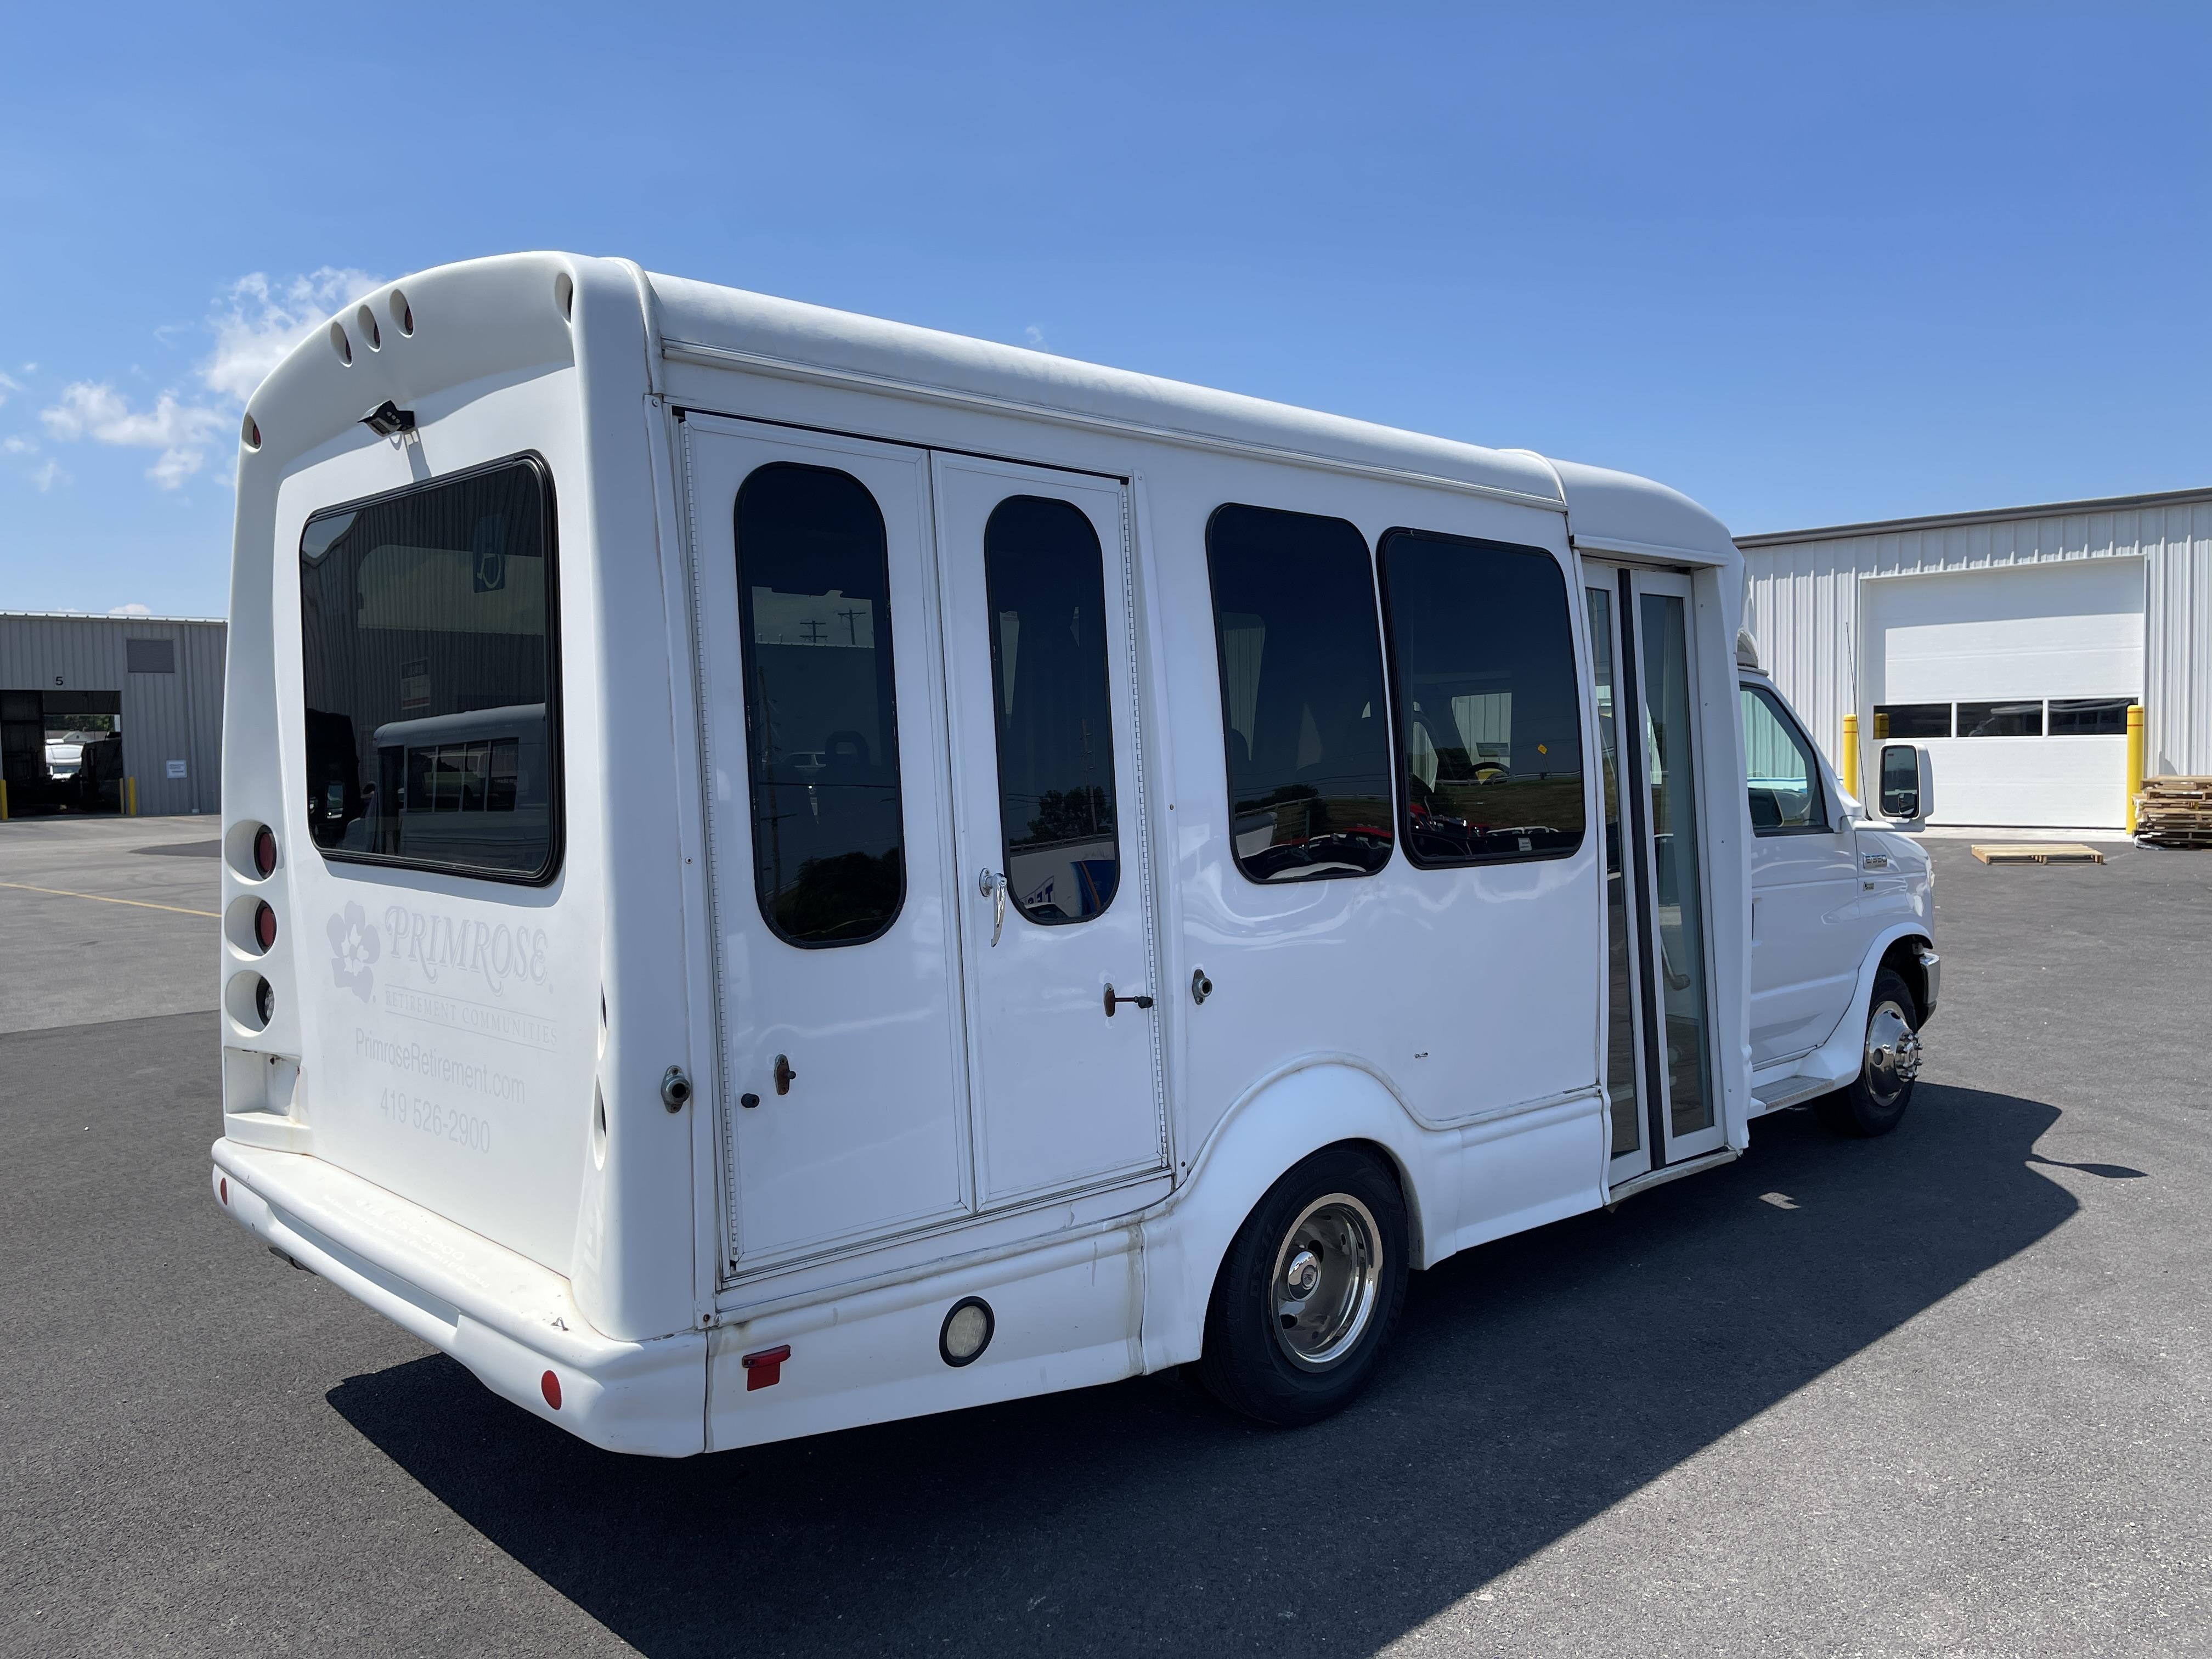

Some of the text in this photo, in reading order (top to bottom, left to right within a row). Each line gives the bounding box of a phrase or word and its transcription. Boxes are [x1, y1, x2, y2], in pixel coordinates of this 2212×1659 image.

[55, 676, 64, 686] 5
[385, 905, 549, 996] PRIMROSE
[386, 991, 557, 1045] RETIREMENT COMMUNITIES
[356, 1028, 526, 1104] PrimroseRetirement.com
[380, 1087, 490, 1154] 419 526-2900
